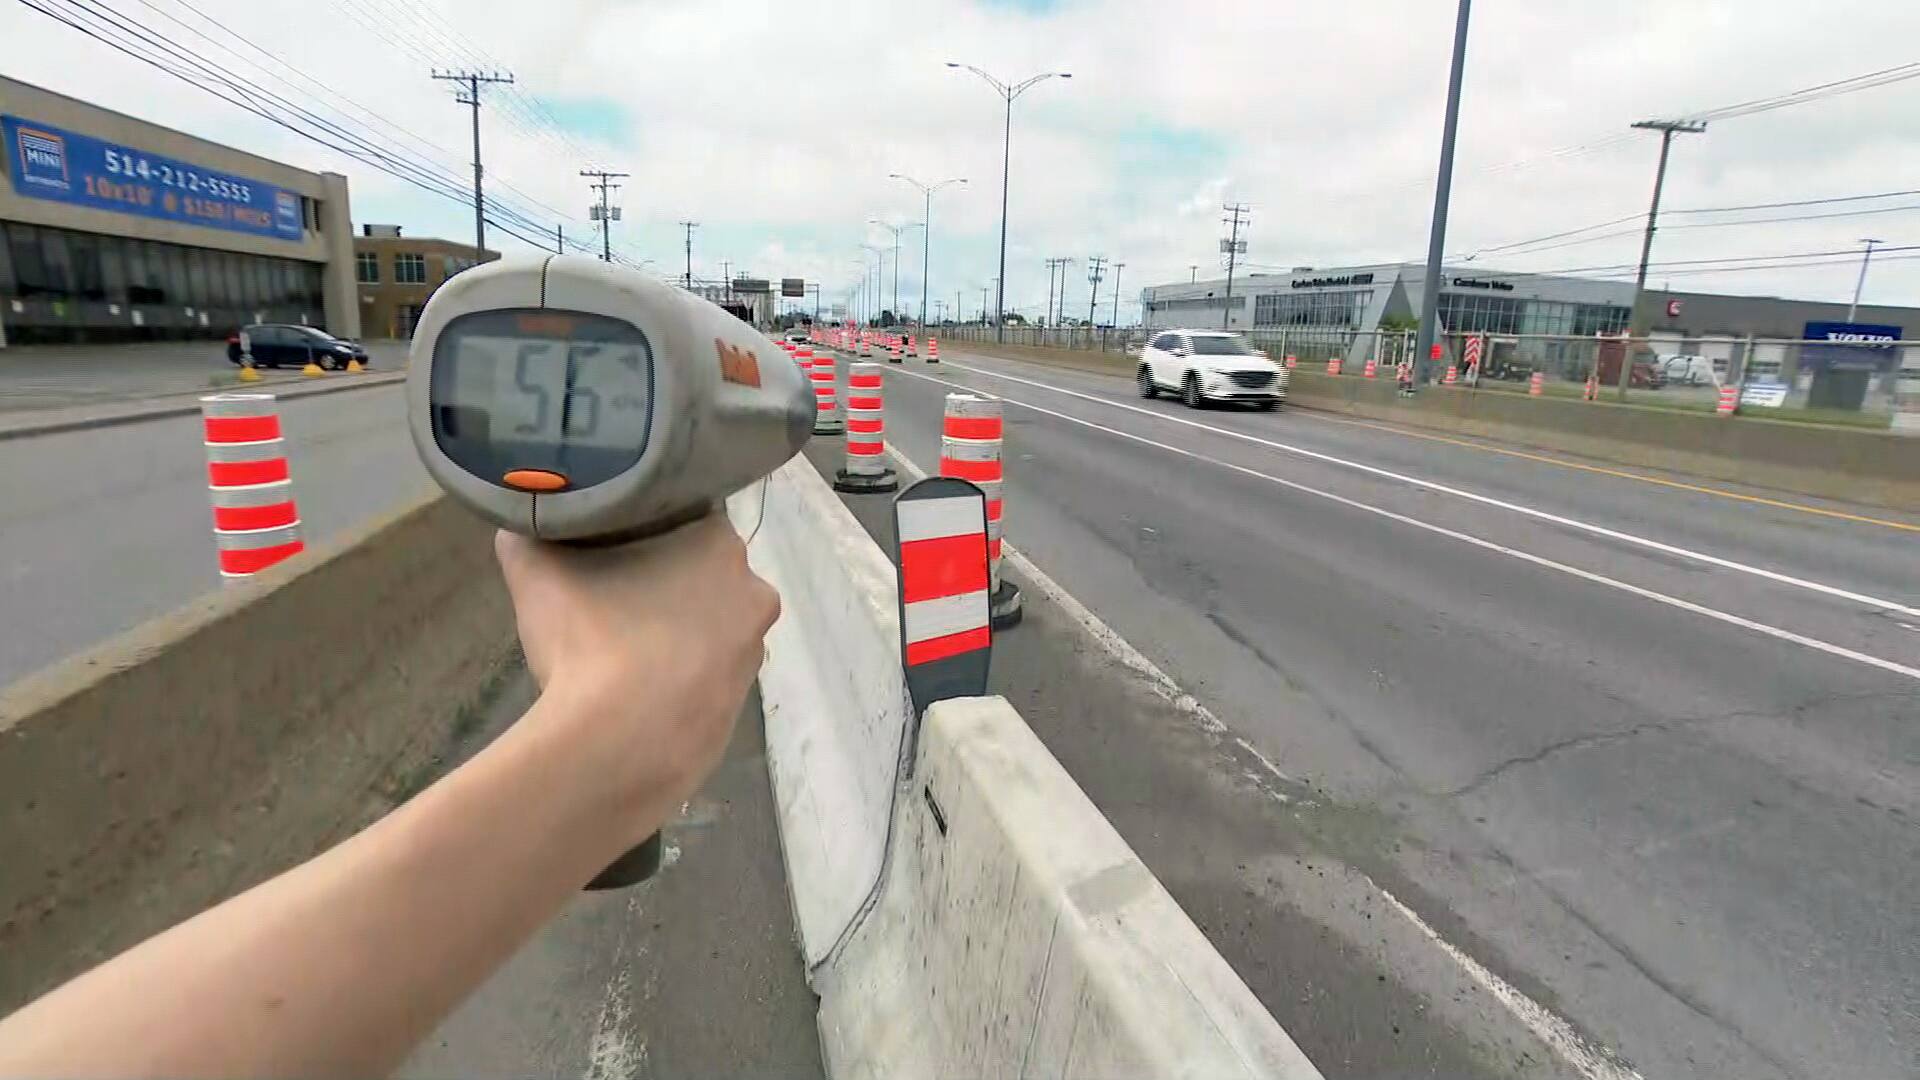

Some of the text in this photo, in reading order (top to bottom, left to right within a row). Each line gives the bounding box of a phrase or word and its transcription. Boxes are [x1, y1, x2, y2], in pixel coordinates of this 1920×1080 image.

[26, 148, 61, 168] MINI
[104, 149, 250, 203] 514-212-5555
[514, 343, 601, 438] 56
